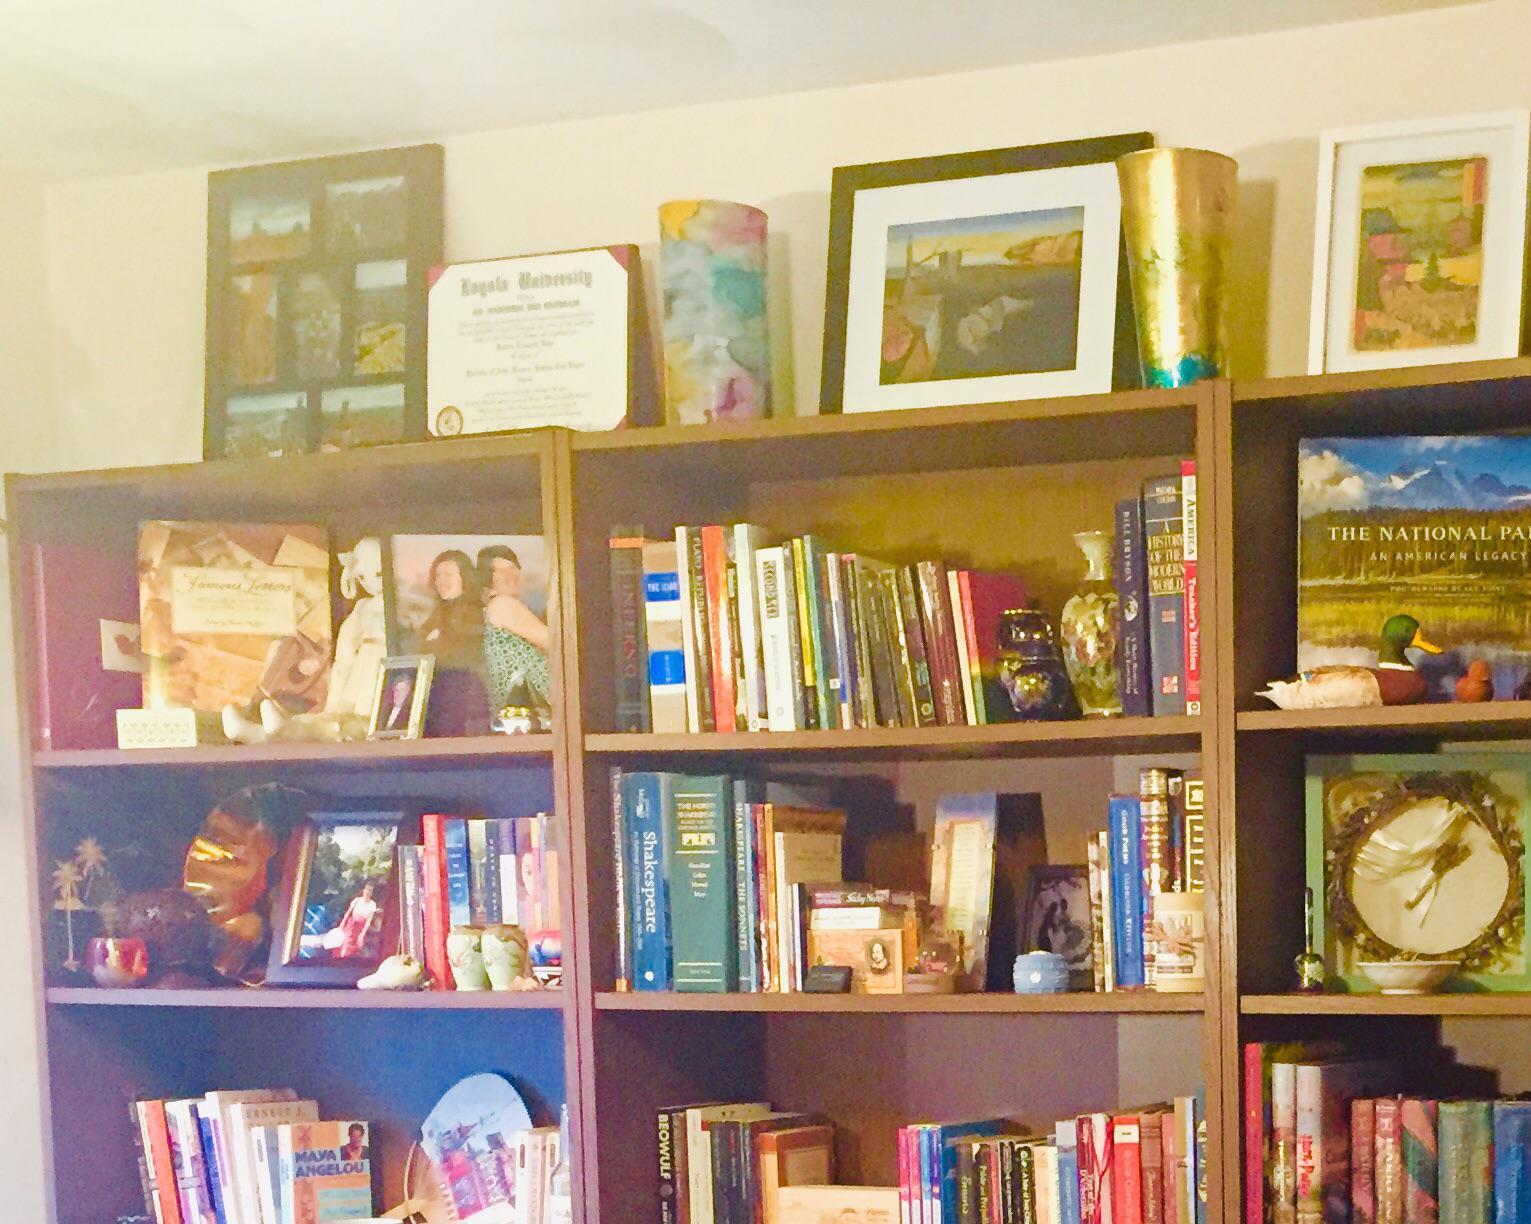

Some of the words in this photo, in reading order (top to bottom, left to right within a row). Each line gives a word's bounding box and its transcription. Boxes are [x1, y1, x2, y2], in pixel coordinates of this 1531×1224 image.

[460, 276, 509, 298] Loyola
[518, 269, 592, 291] University
[1328, 527, 1370, 542] THE
[1380, 527, 1492, 541] NATIONAL
[1370, 552, 1387, 560] AN
[1396, 552, 1467, 561] AMERICAN
[1475, 552, 1528, 561] LEGACY
[736, 803, 745, 872] SHAKESPEARE
[643, 831, 658, 933] Shakespeare
[737, 882, 746, 901] THE
[295, 1150, 336, 1162] MAYA
[658, 1114, 672, 1180] BEOWULF
[296, 1162, 364, 1178] ANGELOU
